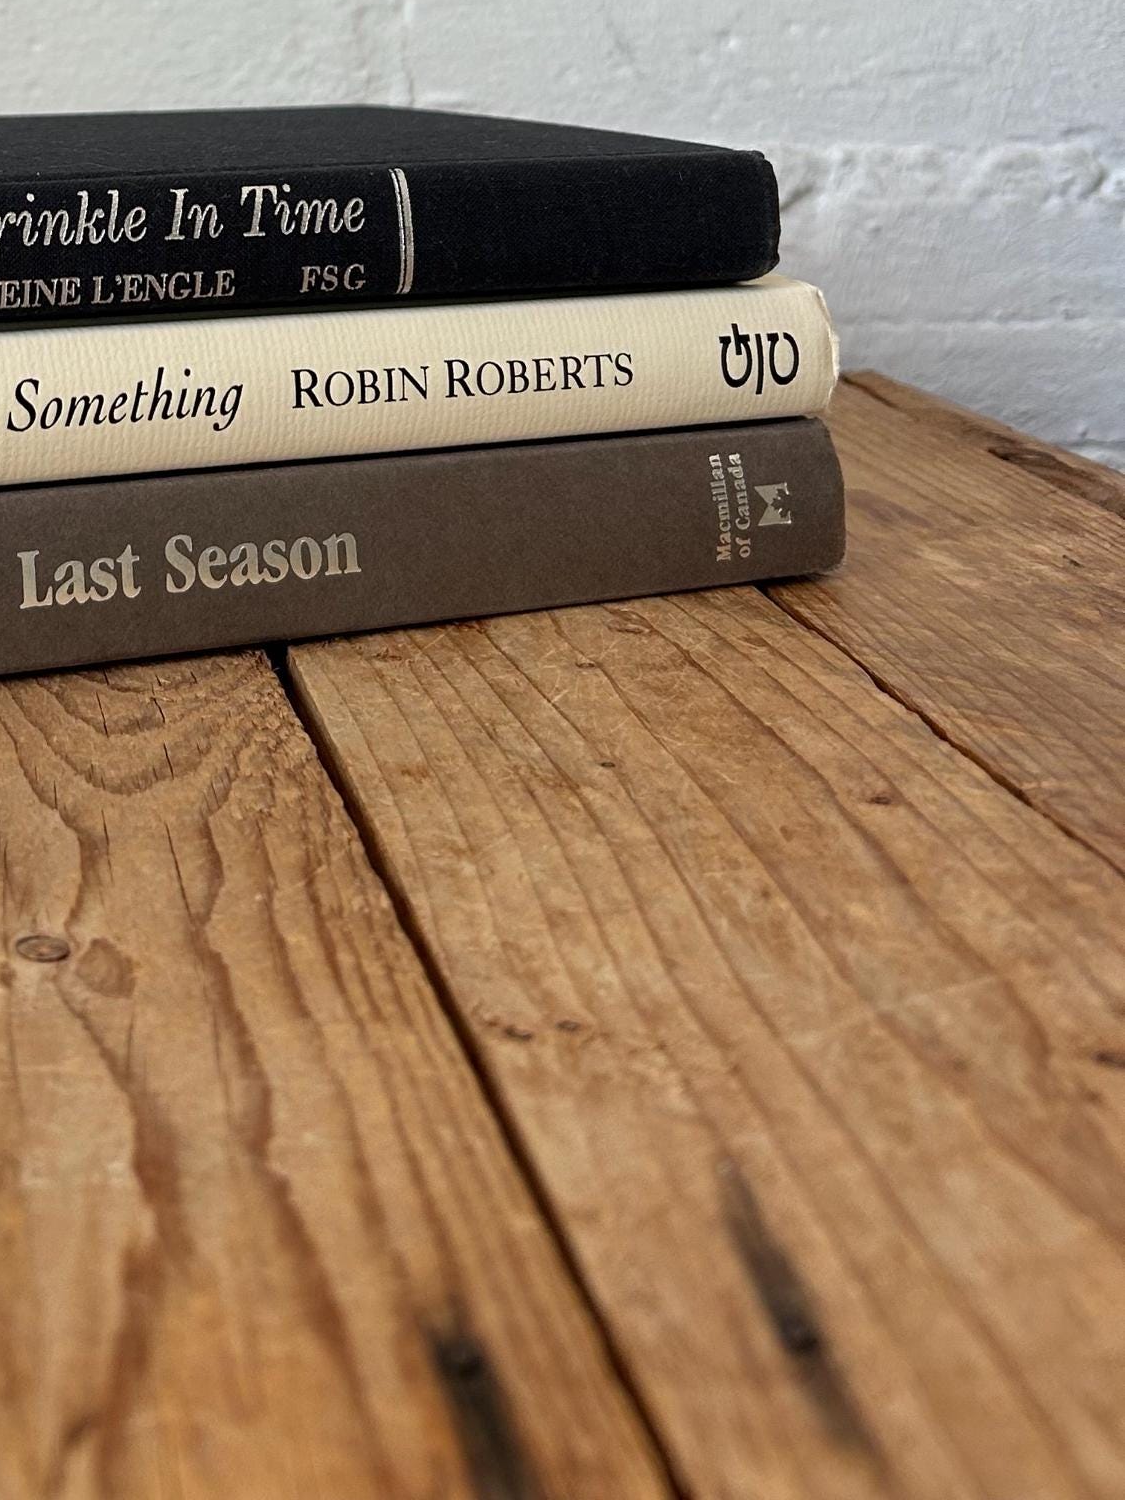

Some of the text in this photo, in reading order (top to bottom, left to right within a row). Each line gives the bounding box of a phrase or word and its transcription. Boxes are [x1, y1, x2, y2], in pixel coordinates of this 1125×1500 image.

[164, 187, 224, 241] In
[240, 183, 366, 238] Time
[91, 269, 236, 305] L'ENGLE
[299, 263, 367, 294] FSG
[6, 366, 244, 433] Something
[290, 365, 430, 409] ROBIN
[443, 352, 634, 399] ROBERTS
[708, 453, 732, 563] Macmillan
[727, 452, 752, 559] of Canada
[16, 543, 142, 610] Last
[164, 532, 362, 594] Season
